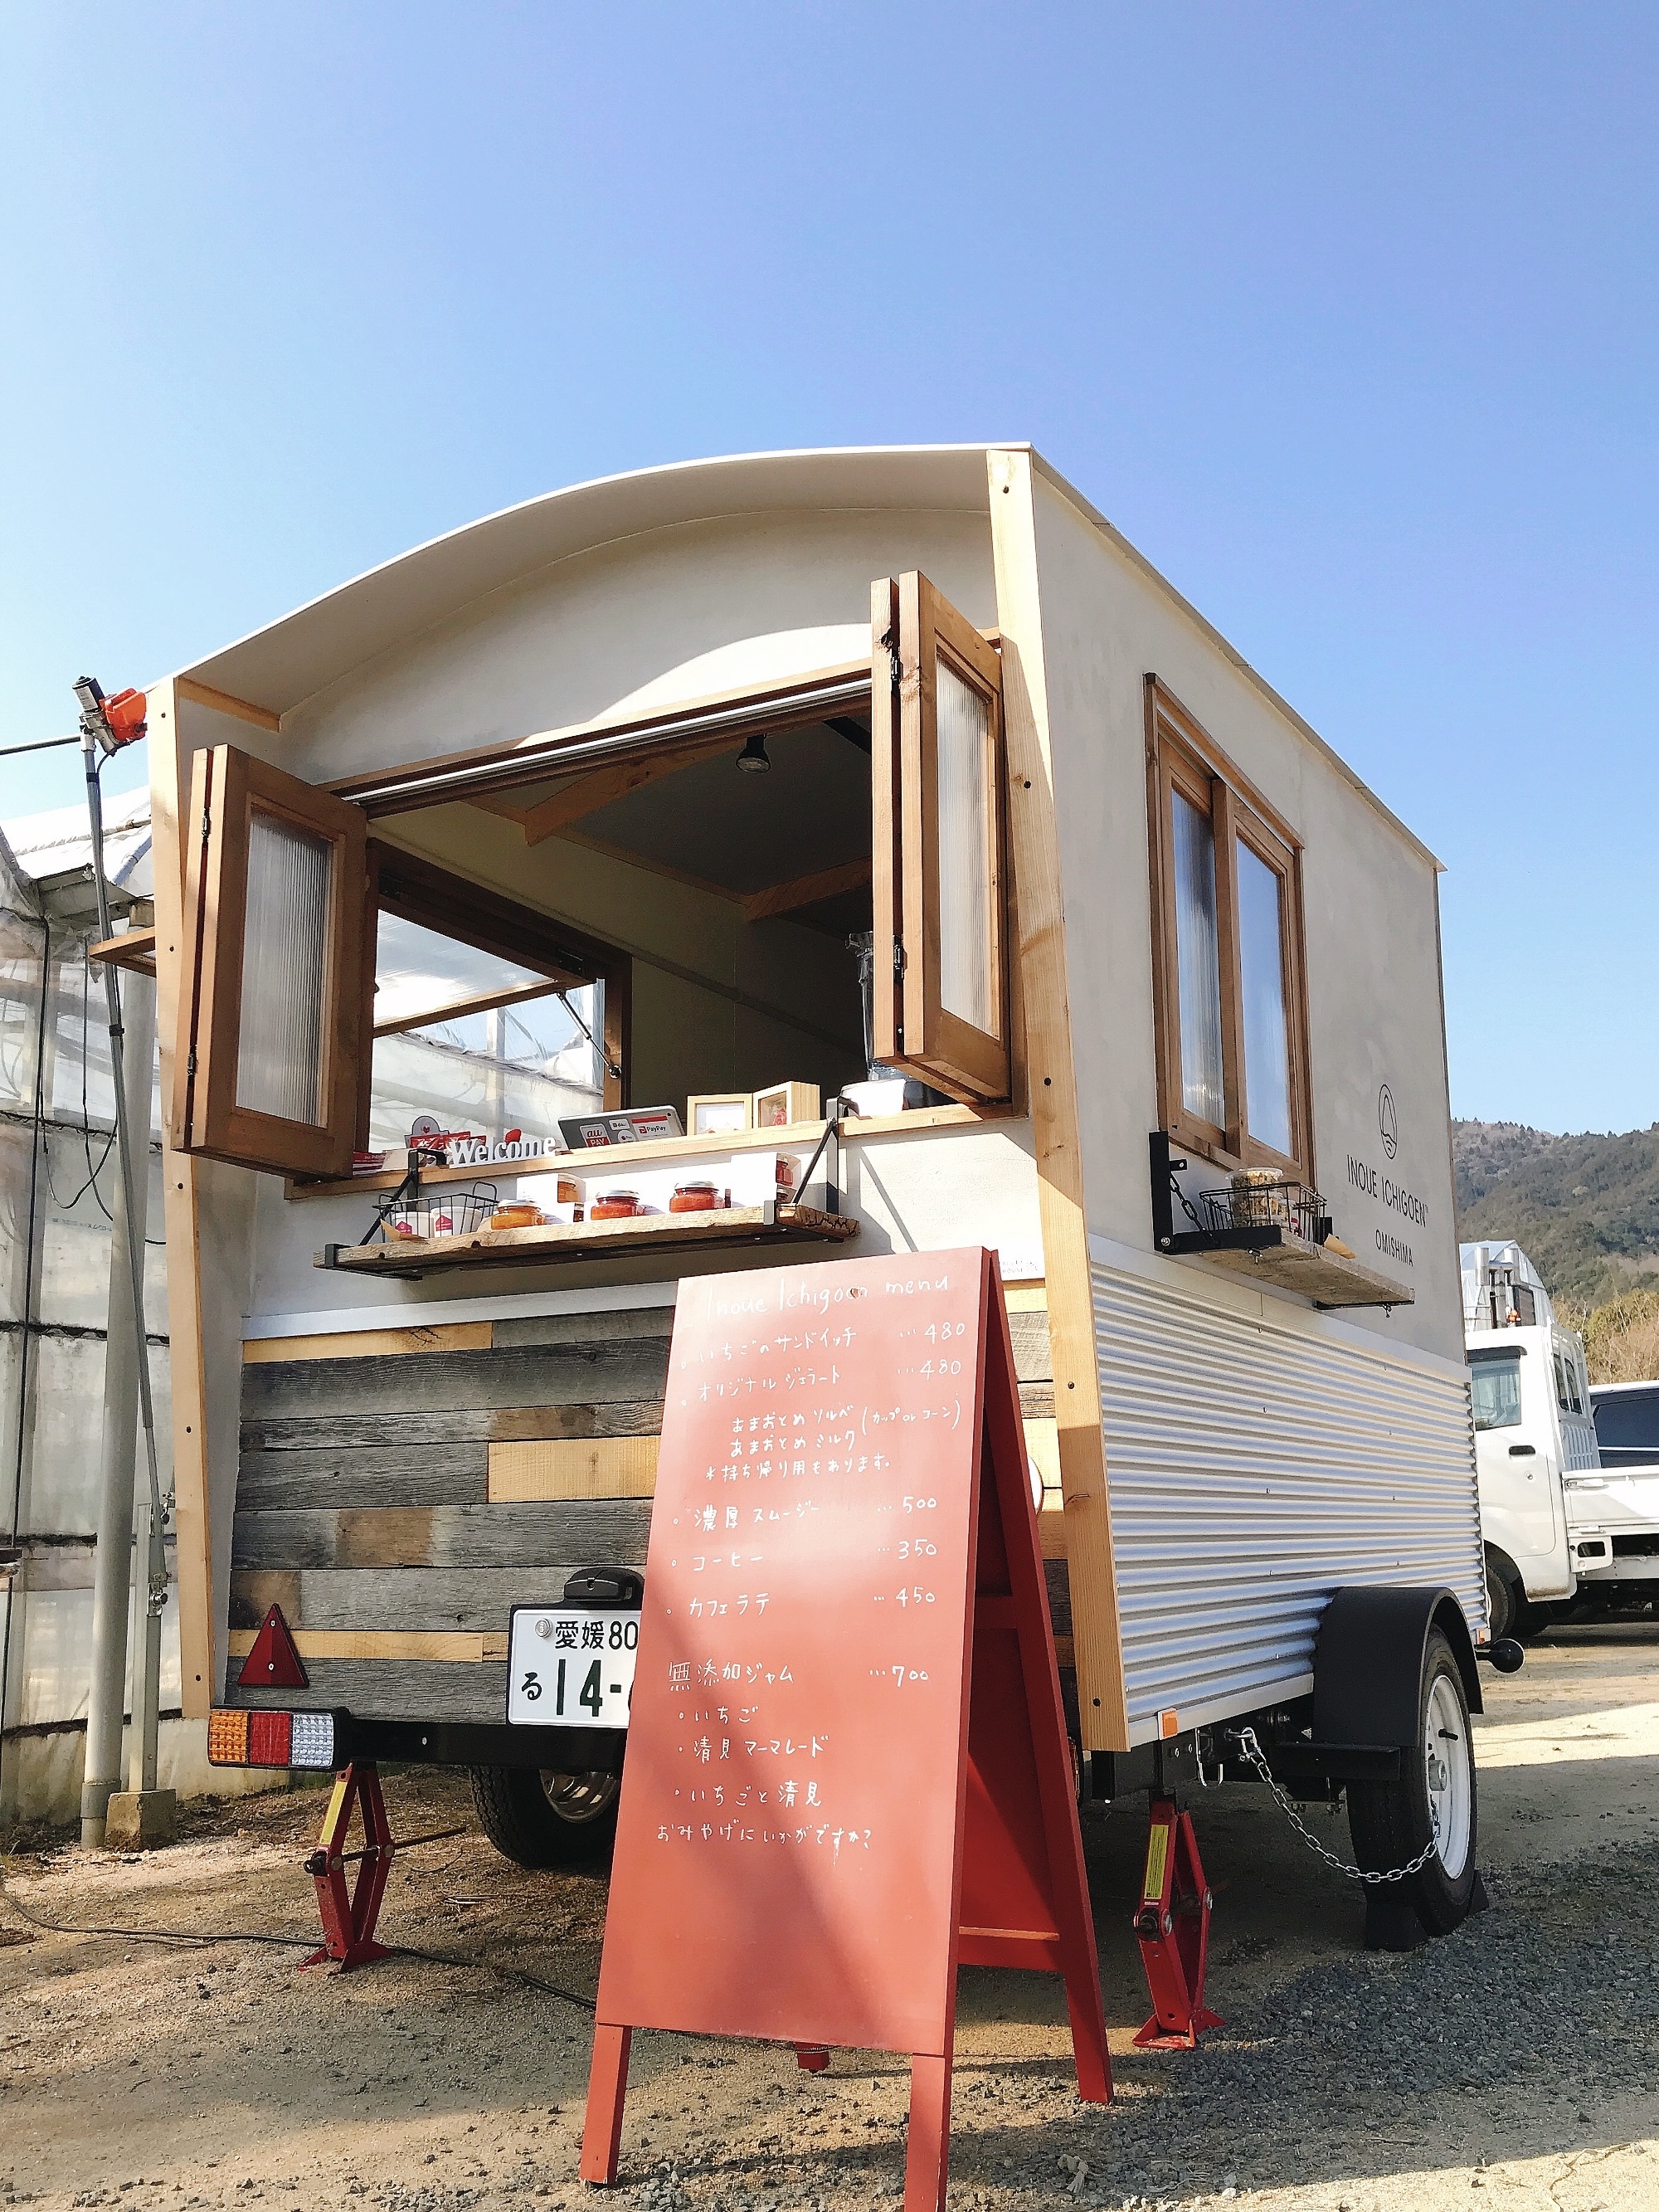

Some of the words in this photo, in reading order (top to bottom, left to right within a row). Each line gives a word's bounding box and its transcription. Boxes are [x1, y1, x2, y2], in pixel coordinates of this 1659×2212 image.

[586, 1129, 603, 1138] au
[448, 1137, 556, 1168] Welcome
[1347, 1154, 1378, 1199] INOUE
[1375, 1228, 1413, 1267] OMISHIMA
[885, 1274, 949, 1295] menu
[692, 1551, 765, 1572] コーヒー
[688, 1592, 771, 1619] カフェラテ
[521, 1671, 542, 1701] る
[556, 1659, 634, 1717] 14-
[693, 1705, 761, 1725] いちご
